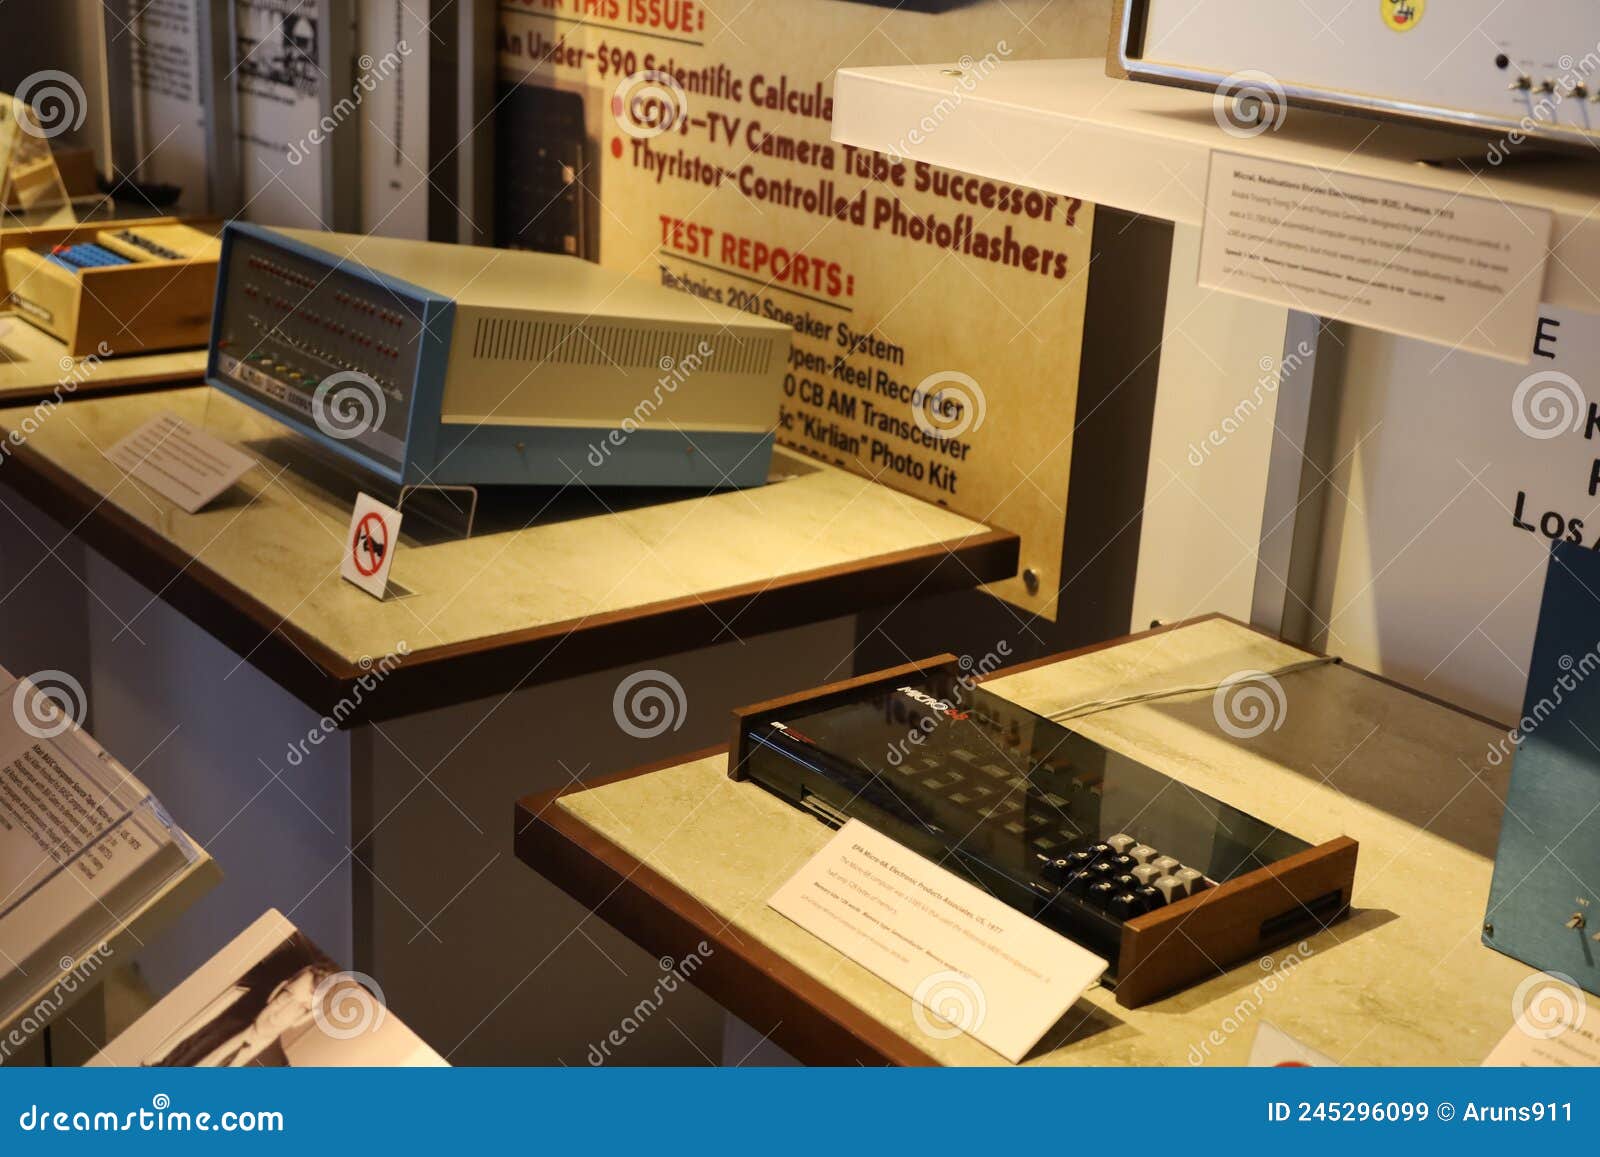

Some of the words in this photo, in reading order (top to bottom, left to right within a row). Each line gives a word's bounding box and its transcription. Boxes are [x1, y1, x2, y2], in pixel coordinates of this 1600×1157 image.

[528, 31, 636, 79] Under-$90
[644, 54, 742, 102] Scientific
[747, 121, 834, 170] Camera
[842, 144, 906, 187] Tube
[914, 161, 1057, 222] Successor
[660, 215, 713, 257] TEST
[722, 232, 855, 296] REPORTS:
[873, 196, 1068, 279] Photoflashers
[659, 266, 723, 303] Technics
[763, 299, 832, 341] Speaker
[837, 322, 904, 365] System
[1533, 317, 1560, 359] E
[800, 376, 824, 407] CB
[827, 389, 856, 420] AM
[862, 401, 970, 461] Transceiver
[876, 370, 963, 421] Recorder
[797, 411, 868, 455] "Kirlian"
[871, 439, 924, 480] Photo
[929, 461, 957, 493] Kit
